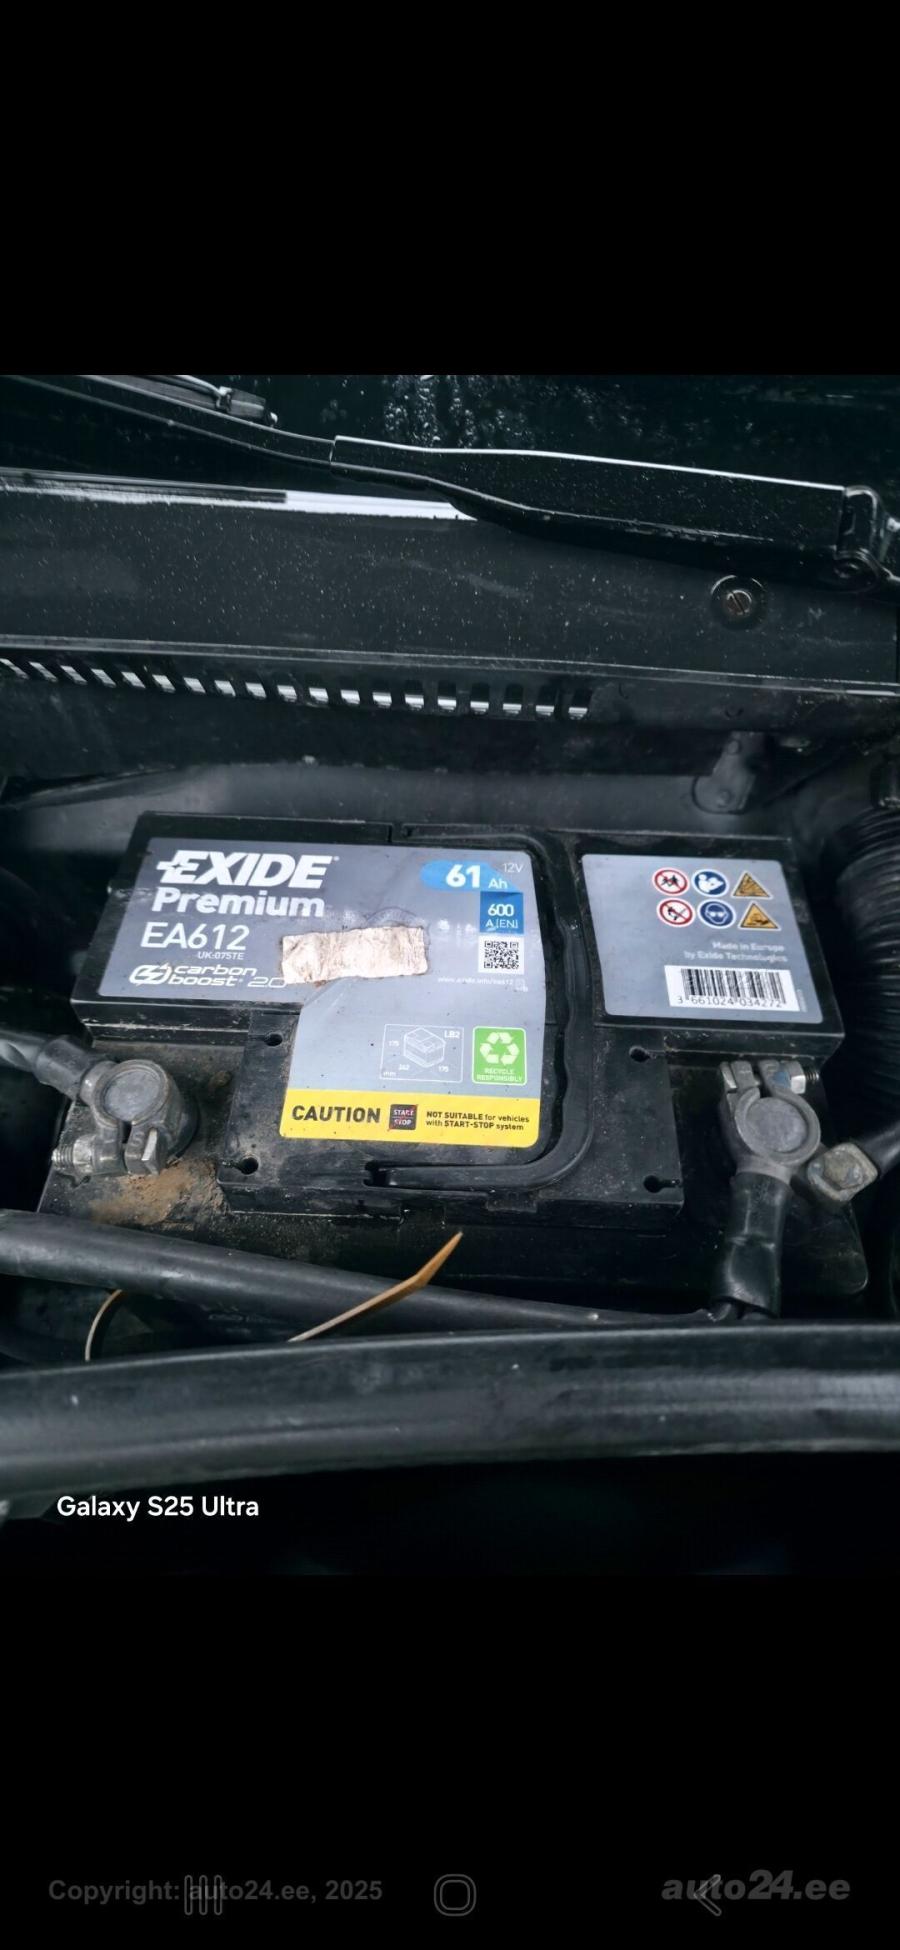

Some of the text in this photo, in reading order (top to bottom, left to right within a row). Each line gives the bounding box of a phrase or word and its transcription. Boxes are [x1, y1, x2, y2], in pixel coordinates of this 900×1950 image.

[157, 850, 333, 889] EXIDE
[503, 863, 524, 873] 12V
[446, 864, 508, 889] 61 Ah
[152, 886, 325, 917] Premium
[487, 904, 514, 917] 600
[140, 922, 250, 951] EA612
[712, 941, 738, 950] Made
[751, 943, 785, 952] Europe
[197, 951, 245, 960] UK-075TE
[684, 951, 788, 963] by Exide Technologies
[174, 964, 257, 976] carbon
[168, 974, 238, 987] boost
[444, 1030, 460, 1038] LB2
[477, 1074, 523, 1082] RESPONSIBLY
[292, 1105, 381, 1124] CAUTION
[444, 1112, 483, 1121] SUITABLE
[497, 1115, 530, 1123] vehicles
[426, 1119, 524, 1131] with START-STOP system
